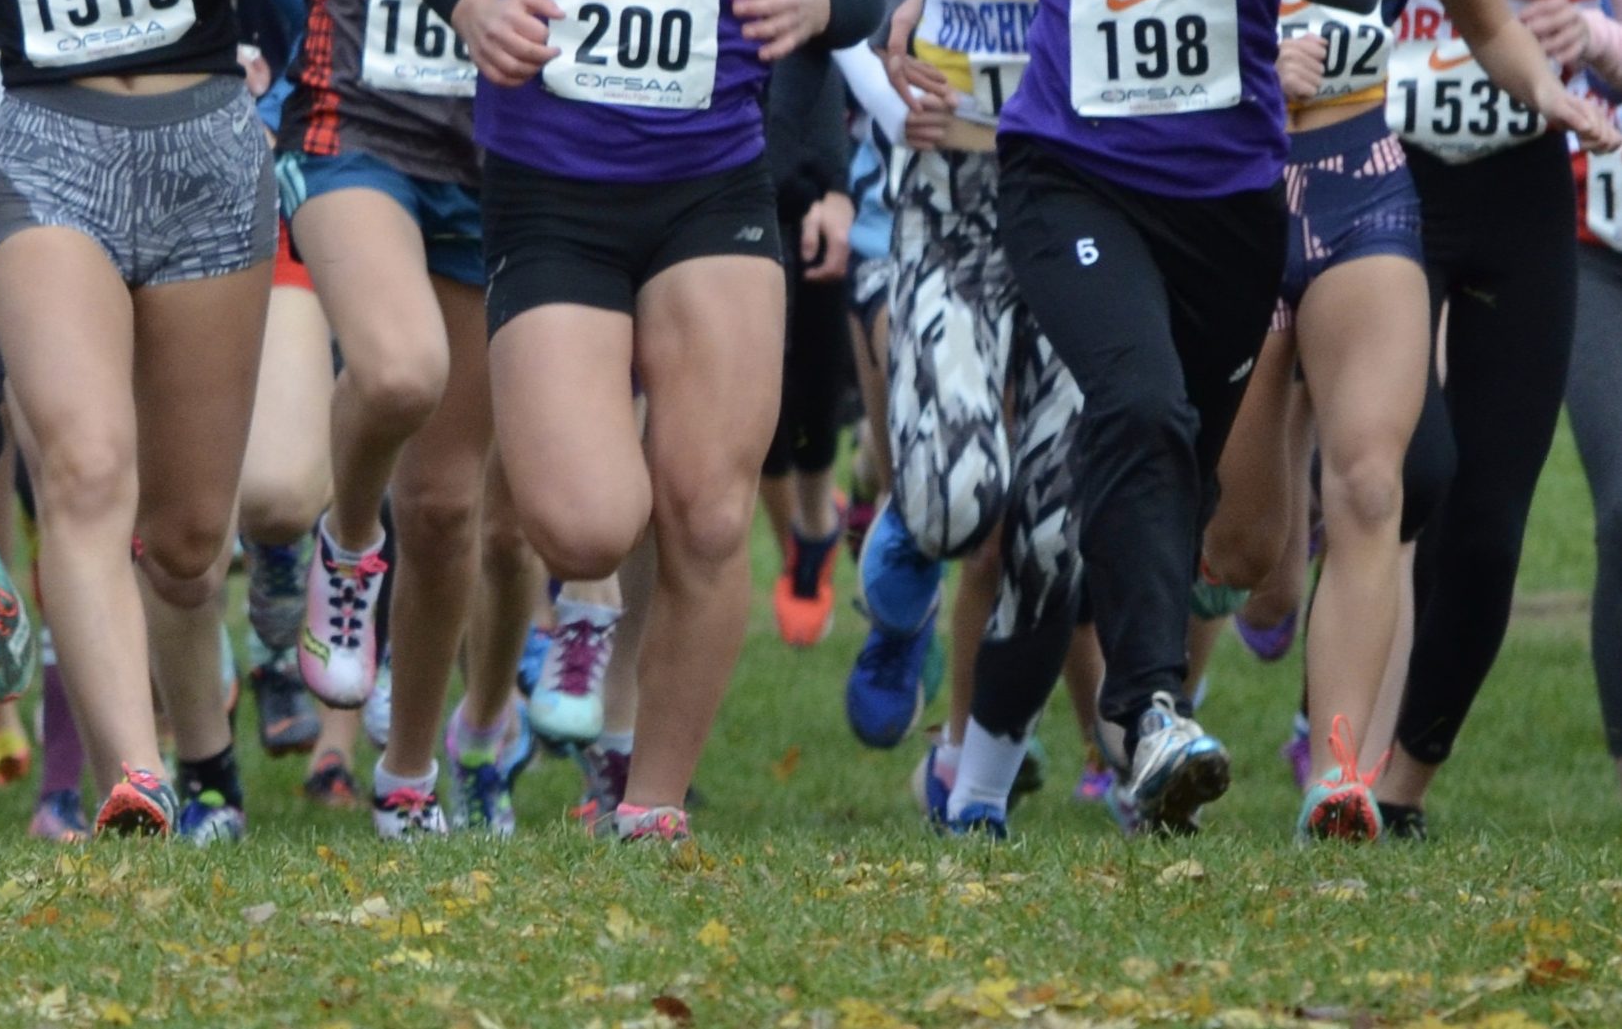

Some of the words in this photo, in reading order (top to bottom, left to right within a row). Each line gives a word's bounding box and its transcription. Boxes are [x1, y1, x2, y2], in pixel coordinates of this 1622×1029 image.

[57, 19, 165, 52] OFSAA
[574, 3, 693, 72] 200
[1097, 14, 1209, 80] 198
[574, 73, 683, 93] OFSAA
